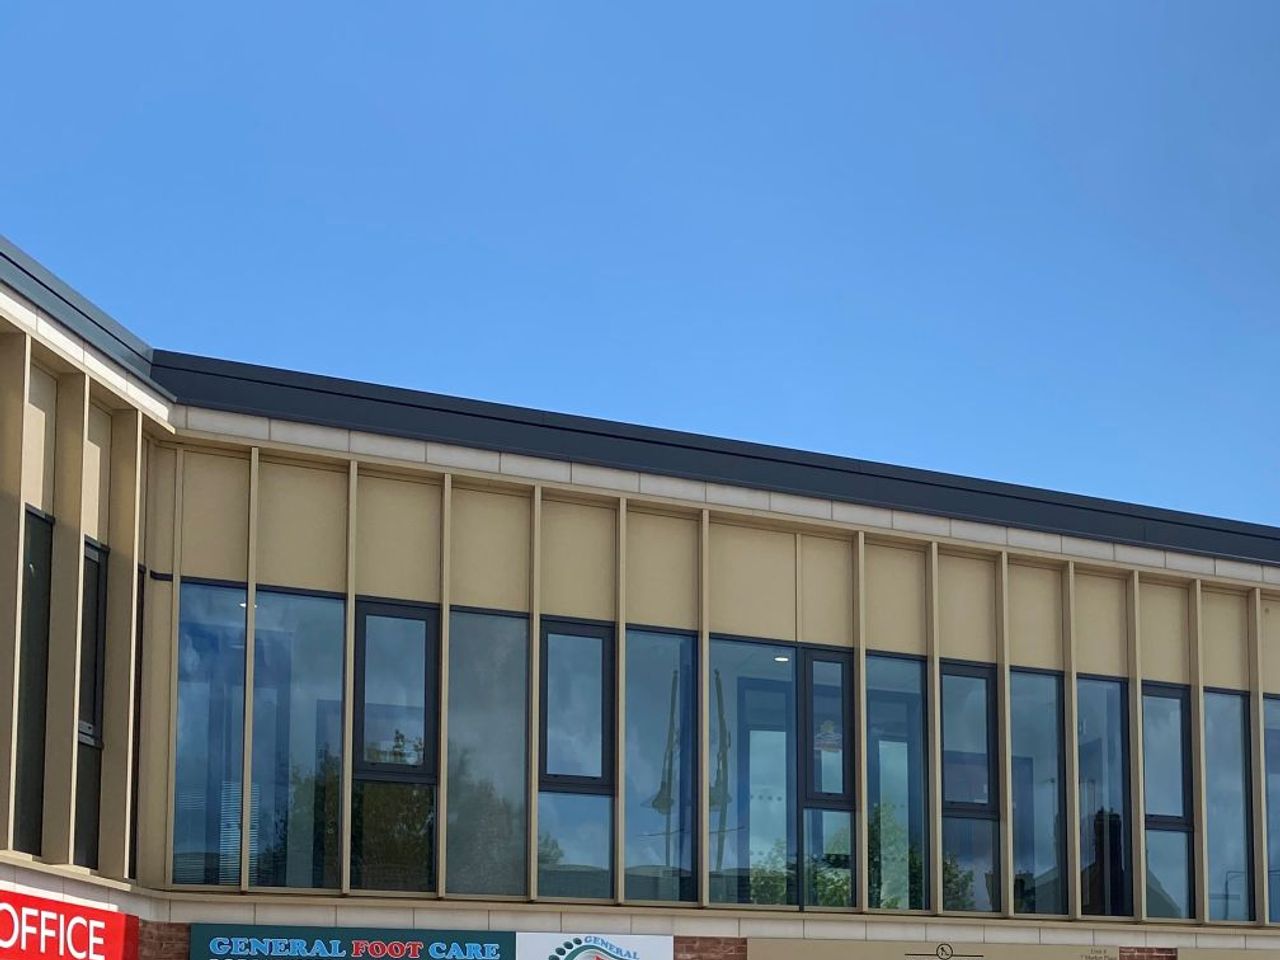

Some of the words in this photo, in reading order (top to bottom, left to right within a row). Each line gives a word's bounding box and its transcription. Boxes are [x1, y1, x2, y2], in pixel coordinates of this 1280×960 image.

[209, 937, 346, 957] GENERAL
[351, 940, 424, 958] FOOT
[429, 942, 500, 960] CARE
[584, 935, 640, 960] GENERAL
